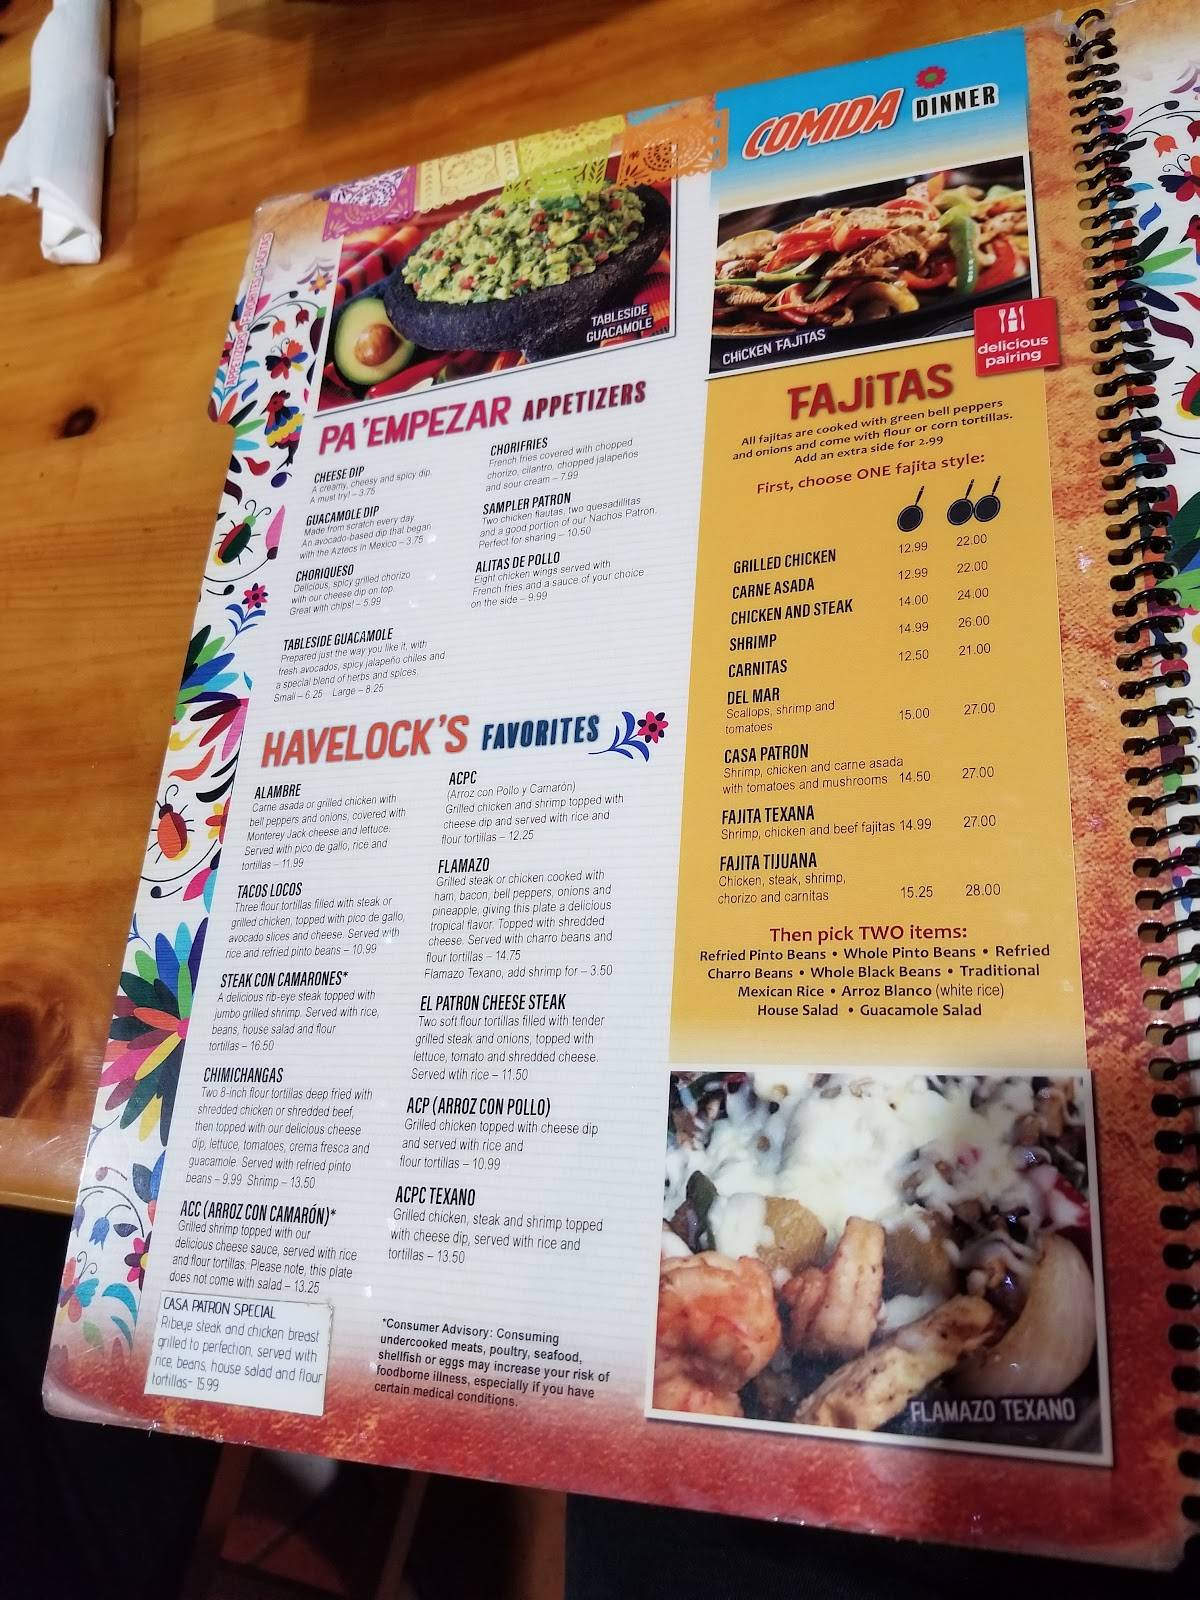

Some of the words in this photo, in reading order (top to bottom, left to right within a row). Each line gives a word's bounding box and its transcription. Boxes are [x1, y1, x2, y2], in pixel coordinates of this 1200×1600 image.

[742, 87, 904, 160] COMIDA
[916, 85, 996, 118] DINNER
[586, 317, 653, 343] GUACAMOLE
[977, 336, 1049, 355] delicious
[985, 350, 1042, 369] pairing
[521, 380, 646, 422] APPETIZERS
[740, 435, 756, 446] All
[758, 431, 792, 444] fajitas
[794, 428, 813, 438] are
[815, 419, 858, 434] cooked
[860, 415, 887, 428] with
[889, 411, 925, 426] green
[927, 405, 949, 417] bell
[952, 400, 1003, 416] peppers
[732, 448, 753, 460] and
[755, 444, 793, 457] onions
[795, 439, 816, 451] and
[819, 436, 850, 447] come
[853, 429, 880, 442] with
[882, 426, 911, 437] flour
[914, 424, 928, 433] or
[930, 420, 958, 430] corn
[960, 412, 1013, 426] tortillas.
[793, 452, 817, 464] Add
[820, 451, 834, 460] an
[836, 447, 867, 458] extra
[870, 441, 894, 453] side
[896, 439, 915, 449] for
[918, 435, 943, 446] 2.99
[313, 467, 348, 484] CHEESE
[348, 465, 365, 478] DIP
[756, 479, 794, 494] First,
[797, 472, 852, 488] choose
[856, 464, 891, 480] ONE
[894, 459, 936, 476] fajita
[940, 452, 985, 469] style:
[482, 497, 530, 515] SAMPLER
[531, 491, 571, 508] PATRON
[305, 507, 362, 526] GUACAMOLE
[362, 505, 380, 518] DIP
[474, 557, 510, 573] ALITAS
[511, 555, 526, 569] DE
[527, 550, 560, 567] POLLO
[733, 555, 781, 574] GRILLED
[784, 548, 836, 568] CHICKEN
[898, 540, 928, 554] 12.99
[955, 532, 987, 547] 22.00
[732, 581, 771, 599] CARNE
[773, 577, 815, 595] ASADA
[897, 567, 928, 580] 12.99
[956, 559, 988, 574] 22.00
[729, 633, 777, 651] SHRIMP
[898, 620, 929, 634] 14.99
[957, 614, 990, 628] 26.00
[727, 689, 749, 705] DEL
[752, 686, 780, 703] MAR
[725, 706, 772, 719] Scallops,
[775, 703, 812, 715] shrimp
[814, 699, 835, 712] and
[725, 722, 773, 735] tomatoes
[899, 707, 930, 720] 15.00
[963, 701, 995, 715] 27.00
[260, 713, 470, 768] HAVELOCK'S
[481, 714, 600, 751] FAVORITES
[448, 769, 477, 786] ACPC
[253, 783, 302, 799] ALAMBRE
[721, 807, 762, 825] FAJITA
[764, 804, 814, 823] TEXANA
[720, 827, 761, 841] Shrimp,
[764, 825, 806, 838] chicken
[809, 823, 830, 836] and
[833, 821, 859, 834] beef
[860, 820, 896, 836] fajitas
[899, 817, 932, 831] 14.99
[963, 814, 996, 828] 27.00
[437, 856, 490, 874] FLAMAZO
[435, 875, 466, 887] Grilled
[468, 874, 493, 886] steak
[495, 875, 506, 884] or
[508, 872, 544, 884] chicken
[546, 869, 583, 882] cooked
[585, 868, 605, 880] with
[237, 883, 268, 899] TACOS
[269, 881, 303, 897] LOCOS
[769, 926, 812, 942] Then
[817, 925, 854, 946] pick
[858, 925, 904, 940] TWO
[909, 923, 967, 939] items:
[220, 972, 253, 988] STEAK
[253, 971, 276, 987] CON
[737, 985, 792, 997] Mexican
[796, 984, 824, 997] Rice
[840, 985, 880, 997] Arroz
[884, 983, 932, 996] Blanco
[935, 983, 973, 999] (white
[977, 982, 1004, 999] rice)
[419, 995, 432, 1011] EL
[435, 994, 480, 1011] PATRON
[481, 993, 526, 1011] CHEESE
[527, 993, 567, 1010] STEAK
[757, 1004, 799, 1016] House
[802, 1003, 838, 1016] Salad
[859, 1003, 938, 1016] Guacamole
[942, 1002, 981, 1016] Salad
[414, 1032, 445, 1047] grilled
[446, 1031, 473, 1044] steak
[475, 1032, 495, 1044] and
[496, 1034, 531, 1046] onions,
[535, 1031, 571, 1047] topped
[572, 1031, 594, 1044] with
[203, 1066, 284, 1083] CHIMICHANGAS
[406, 1096, 430, 1114] ACP
[432, 1095, 477, 1116] (ARROZ
[478, 1097, 504, 1115] CON
[506, 1096, 550, 1118] POLLO)
[194, 1119, 214, 1132] then
[215, 1120, 246, 1135] topped
[247, 1122, 266, 1133] with
[267, 1124, 284, 1134] our
[284, 1121, 325, 1135] delicious
[326, 1123, 362, 1136] cheese
[403, 1117, 437, 1131] Grilled
[438, 1118, 477, 1131] chicken
[479, 1120, 515, 1135] topped
[517, 1120, 538, 1133] with
[540, 1120, 579, 1134] cheese
[581, 1121, 599, 1138] dip
[394, 1185, 427, 1204] ACPC
[429, 1186, 476, 1206] TEXANO
[163, 1296, 189, 1311] CASA
[191, 1298, 231, 1315] PATRON
[232, 1302, 275, 1319] SPECIAL
[441, 1322, 493, 1340] Advisory:
[496, 1327, 559, 1347] Consuming
[380, 1334, 448, 1350] undercooked
[450, 1341, 486, 1355] meats,
[488, 1345, 530, 1360] poultry,
[533, 1348, 582, 1365] seafood,
[911, 1399, 996, 1423] FLAMAZO
[1001, 1397, 1076, 1422] TEXANO
